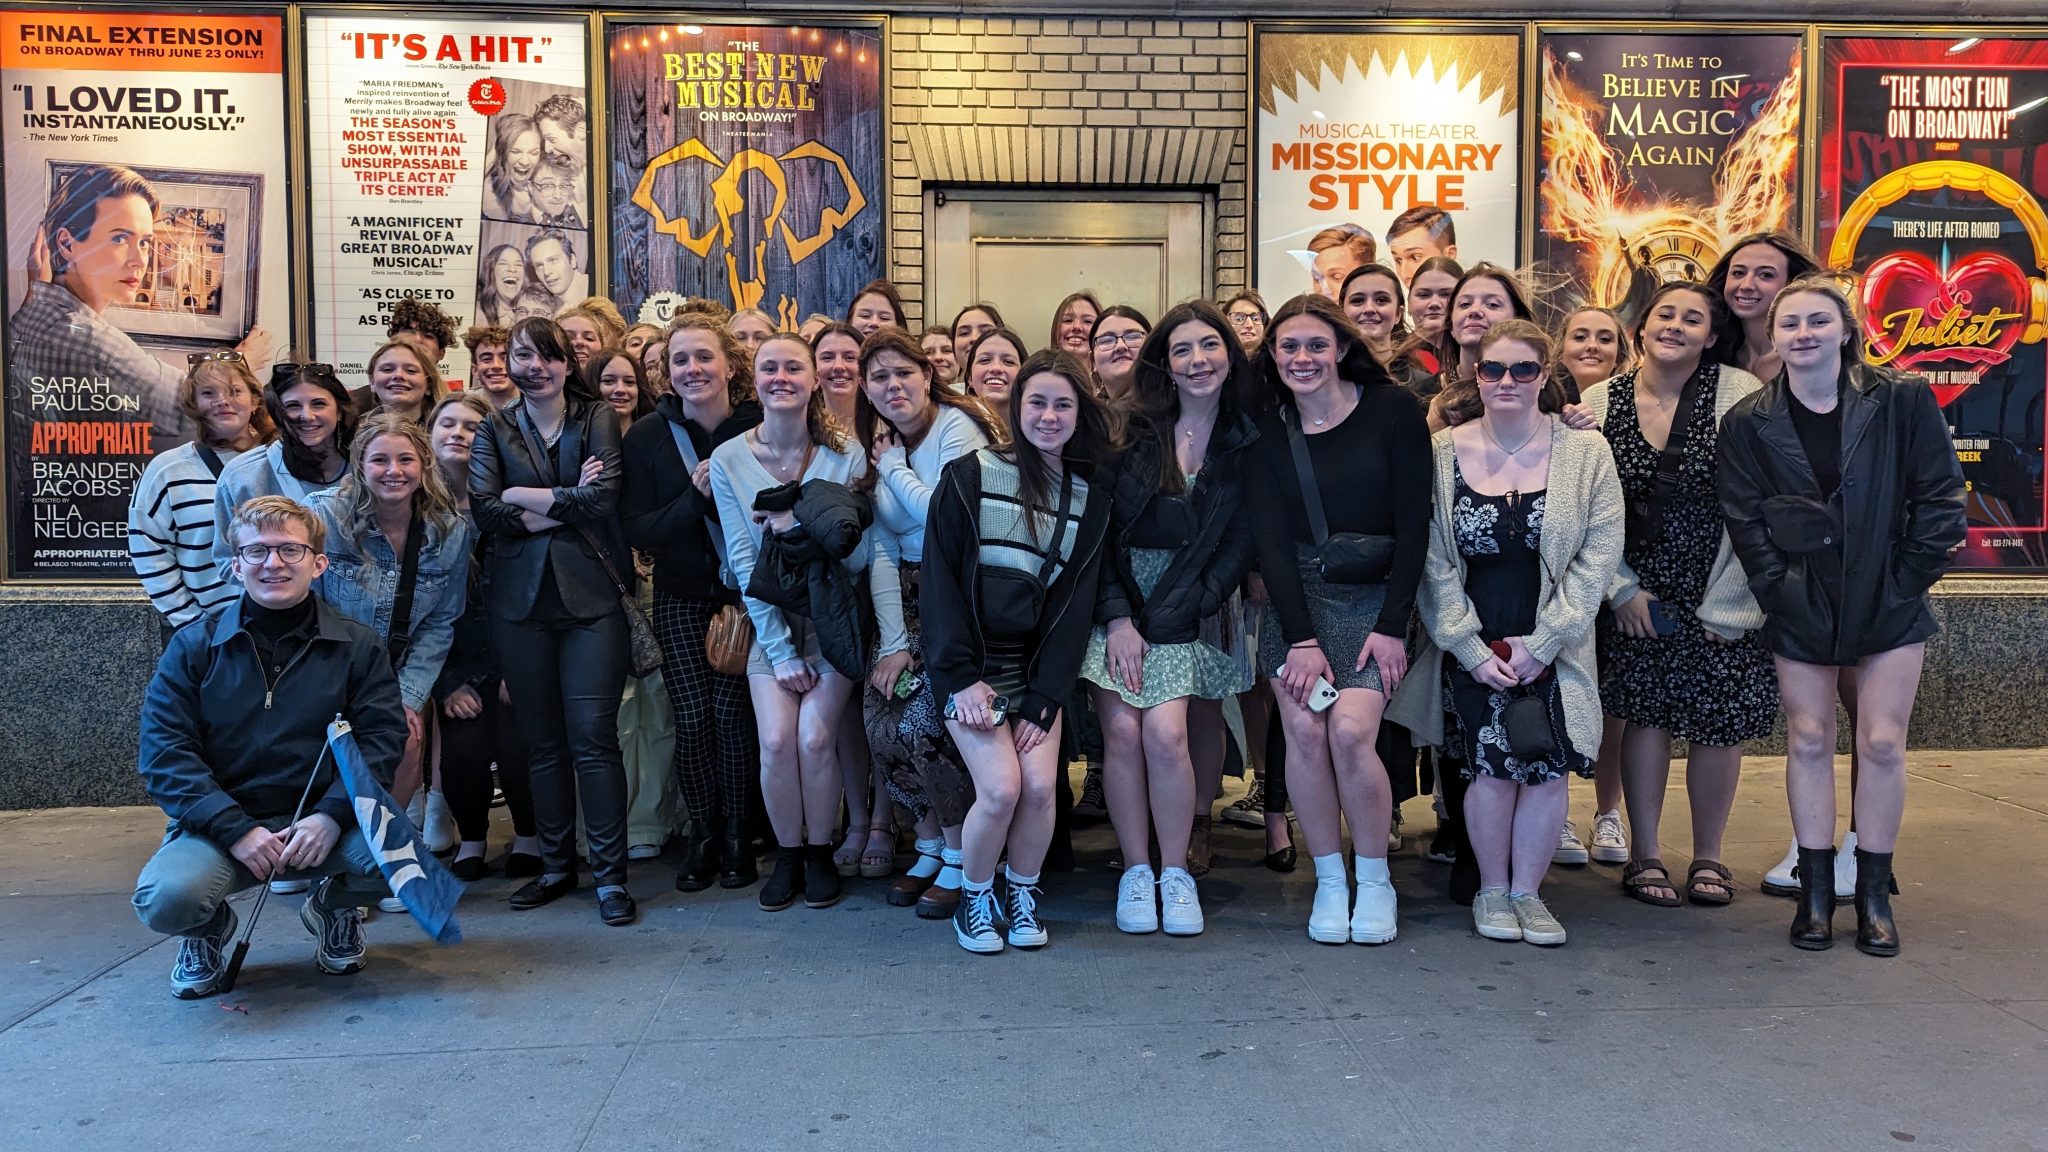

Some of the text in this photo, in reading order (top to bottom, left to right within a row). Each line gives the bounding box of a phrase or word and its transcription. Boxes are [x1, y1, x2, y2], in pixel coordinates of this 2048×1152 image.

[20, 24, 262, 46] FINAL EXTENSION
[20, 45, 264, 59] ON BROADWAY THRU JUNE 23 ONLY!
[435, 35, 462, 61] A
[471, 35, 552, 64] HIT."
[461, 63, 474, 71] York
[663, 52, 827, 82] BEST NEW
[1653, 54, 1694, 69] TIME
[1699, 57, 1722, 69] TO
[357, 89, 390, 97] inspired
[1603, 73, 1740, 99] BELIEVE IN
[1925, 76, 1972, 108] MOST
[1976, 77, 2008, 108] FUN
[46, 85, 182, 114] LOVED
[193, 88, 236, 114] IT.
[344, 98, 373, 106] Merrily
[404, 99, 445, 107] Broadway
[447, 99, 463, 107] feel
[676, 81, 815, 111] MUSICAL
[350, 108, 374, 116] newly
[392, 108, 410, 117] fully
[433, 110, 458, 118] again.
[699, 111, 719, 122] ON
[1606, 102, 1737, 136] MAGIC
[23, 114, 245, 131] INSTANTANEOUSLY."
[350, 117, 456, 129] THE SEASON'S
[1888, 109, 1910, 138] ON
[29, 133, 45, 141] The
[48, 133, 68, 141] New
[70, 134, 90, 142] York
[92, 134, 118, 142] Times
[343, 130, 467, 143] MOST ESSENTIAL
[1300, 123, 1478, 140] MUSICAL THEATER.
[348, 144, 461, 157] SHOW, WITH AN
[1272, 142, 1503, 171] MISSIONARY
[1626, 141, 1715, 167] AGAIN
[341, 157, 468, 170] UNSURPASSABLE
[354, 171, 456, 183] TRIPLE ACT AT
[361, 185, 384, 196] ITS
[1307, 174, 1469, 211] STYLE.
[363, 217, 463, 228] MAGNIFICENT
[1893, 221, 2000, 239] THERE'S LIFE AFTER ROMEO
[360, 230, 454, 242] REVIVAL OF A
[341, 243, 473, 255] GREAT BROADWAY
[385, 289, 432, 299] CLOSE
[435, 289, 454, 300] TO
[358, 315, 378, 326] AS
[1864, 304, 2023, 366] Juliet
[31, 377, 109, 394] SARAH
[1937, 371, 1950, 384] HIT
[1950, 371, 1980, 384] MUSICAL
[32, 394, 140, 411] PAULSON
[31, 421, 154, 455] APPROPRIATE
[1974, 439, 1990, 450] FROM
[33, 462, 145, 479] BRANDEN
[34, 504, 82, 521] LILA
